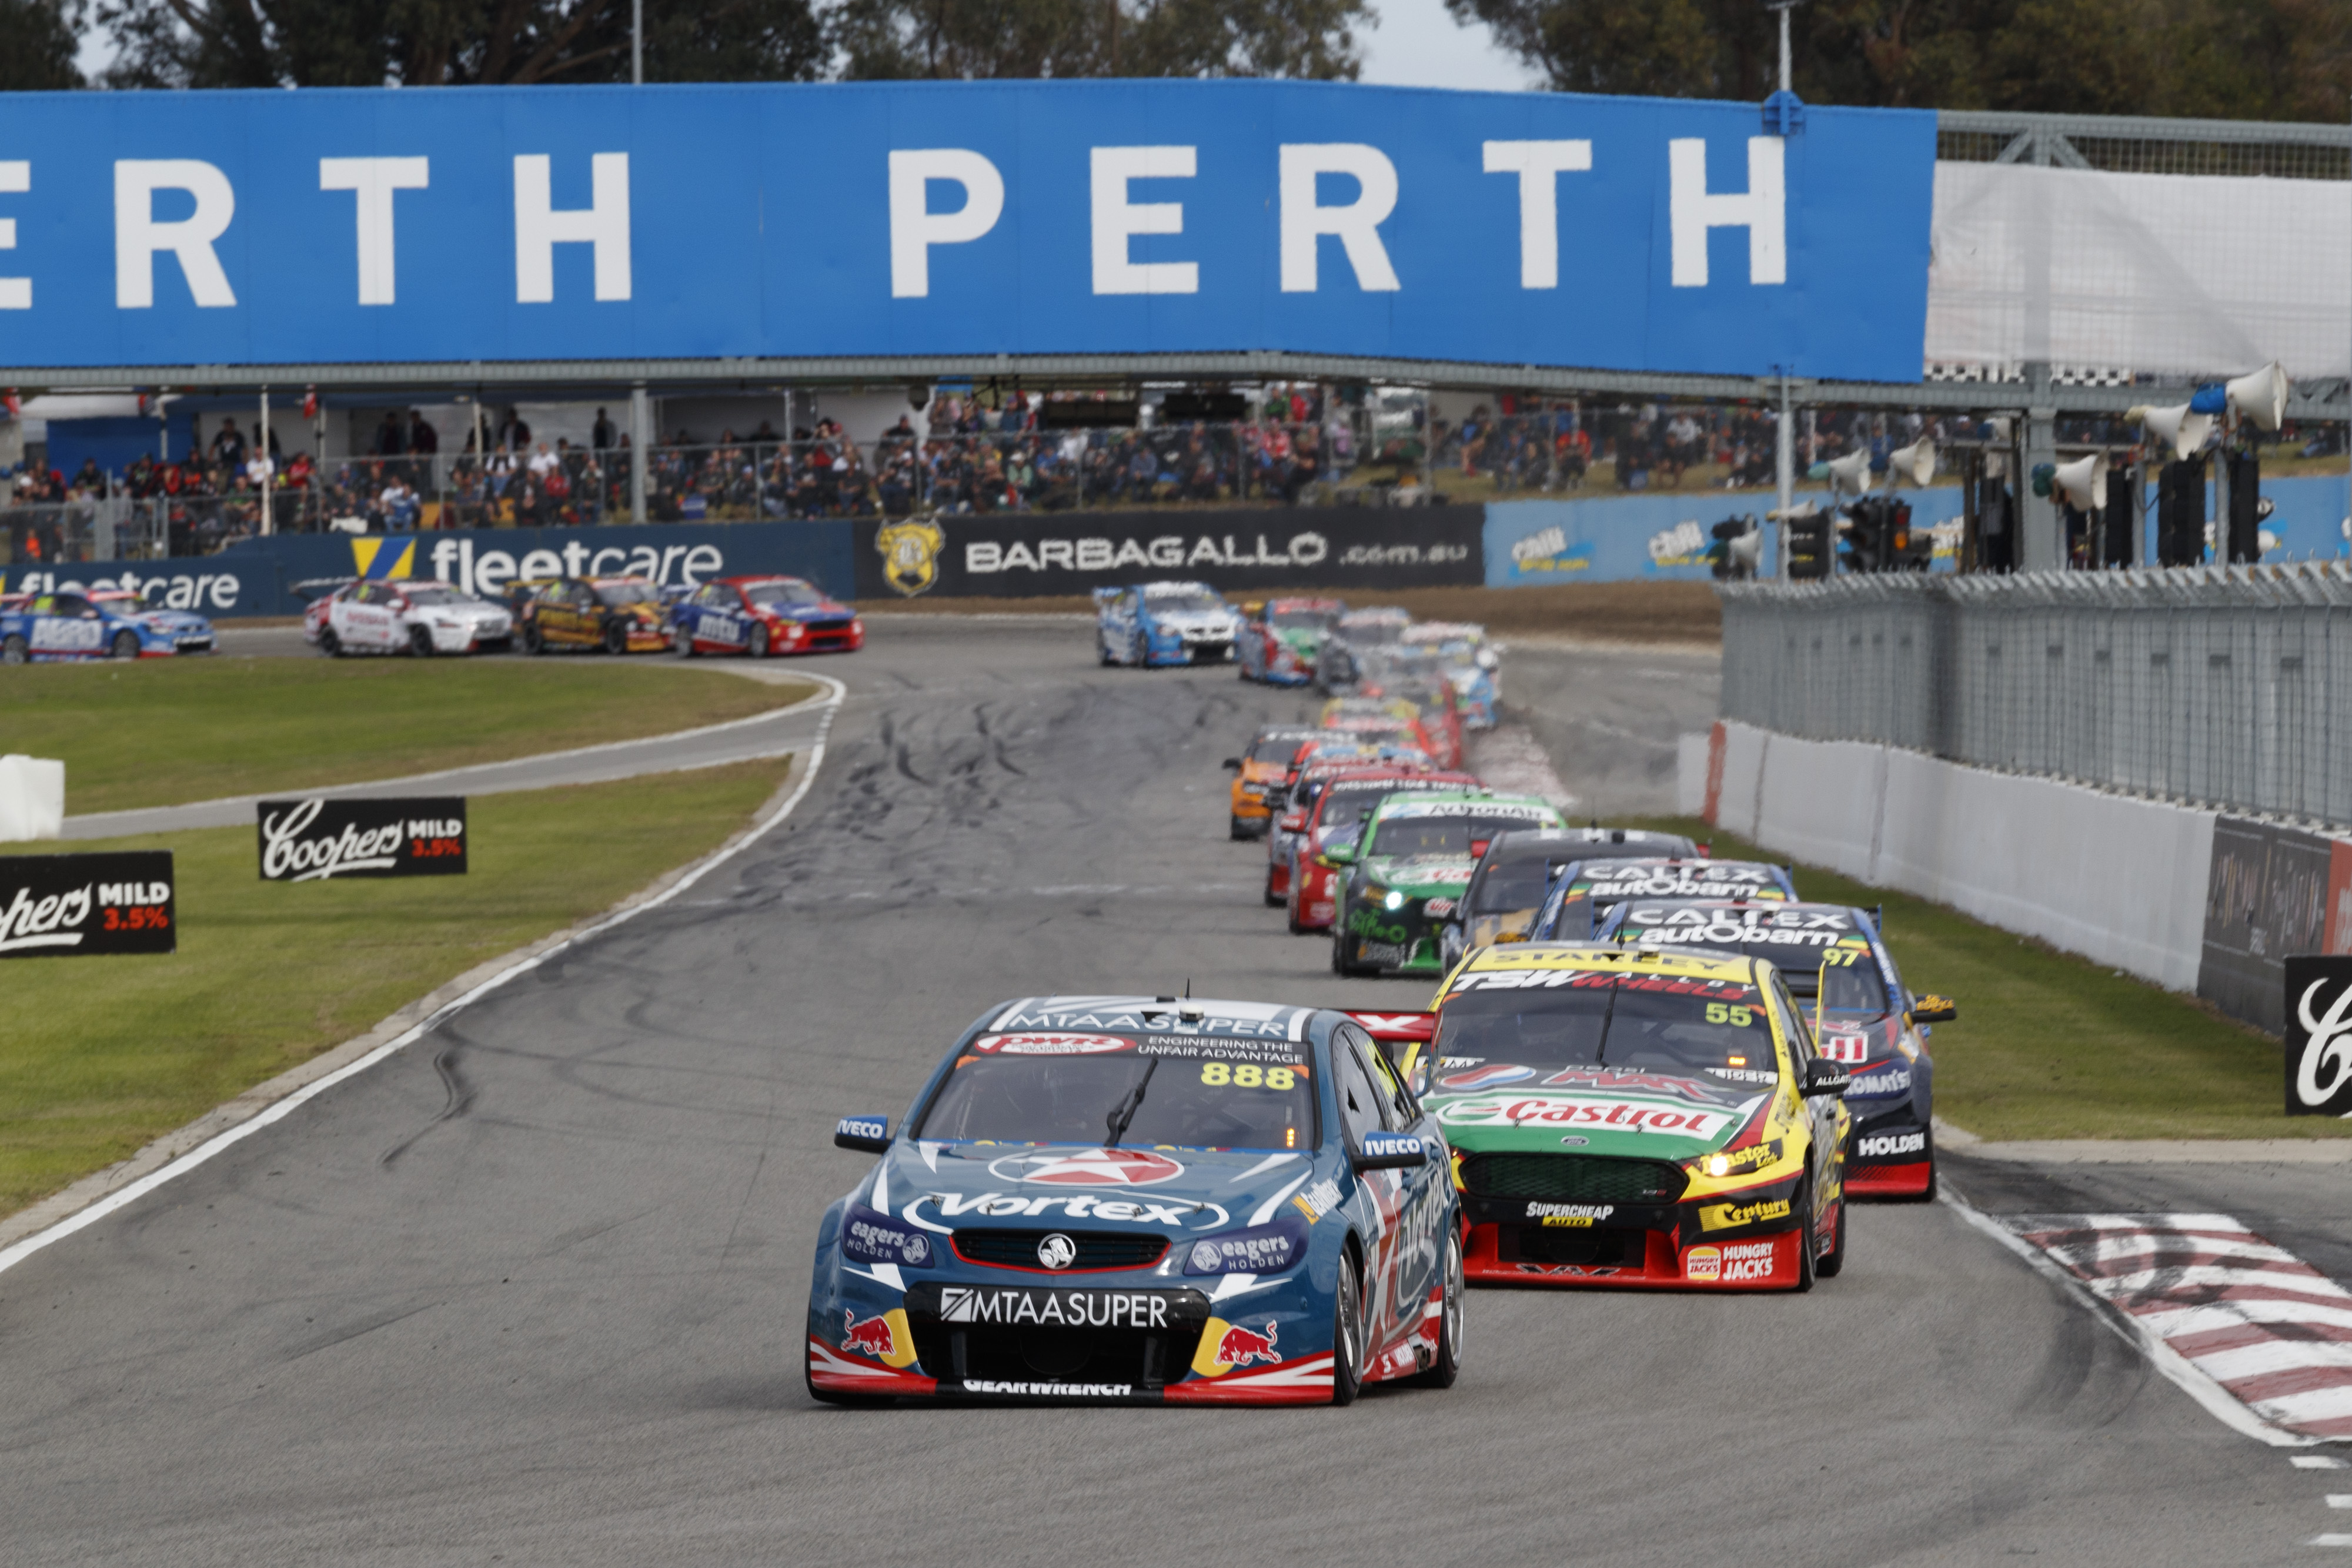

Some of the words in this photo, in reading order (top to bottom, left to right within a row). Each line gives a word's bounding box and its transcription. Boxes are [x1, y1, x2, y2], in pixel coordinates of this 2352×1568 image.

[0, 152, 631, 309] RTH
[965, 532, 1328, 573] BARBAGALLO
[430, 539, 723, 595] fleetcare
[19, 571, 240, 609] fltcare
[263, 799, 405, 882] Coopers
[407, 819, 463, 839] MILD
[412, 839, 462, 857] 3.5%
[0, 882, 93, 949] pers
[98, 881, 171, 907] MILD
[103, 906, 169, 931] 3.5%
[1823, 948, 1860, 967] 97
[1451, 969, 1601, 992] TSW
[1008, 1012, 1285, 1037] MTAASPER
[1705, 1002, 1752, 1028] 55
[1138, 1045, 1198, 1058] UNFAIR
[1202, 1049, 1304, 1064] ADVANTAGE
[1148, 1035, 1258, 1051] ENGINEERING
[1261, 1041, 1293, 1052] THE
[1201, 1062, 1295, 1091] 888
[1506, 1100, 1710, 1132] Castrol
[837, 1119, 883, 1139] IVECO
[1365, 1138, 1421, 1156] IVECO
[1858, 1132, 1925, 1156] HOLDEN
[927, 1191, 1194, 1226] Vortex
[1525, 1201, 1614, 1221] SUPERCHEAP
[1699, 1198, 1790, 1232] Century
[851, 1221, 905, 1247] eagers
[1548, 1218, 1587, 1226] AUTO
[847, 1238, 893, 1260] HOLDEN
[1221, 1236, 1289, 1261] eagers
[1723, 1242, 1773, 1261] HUNGRY
[1228, 1255, 1285, 1271] HOLDEN
